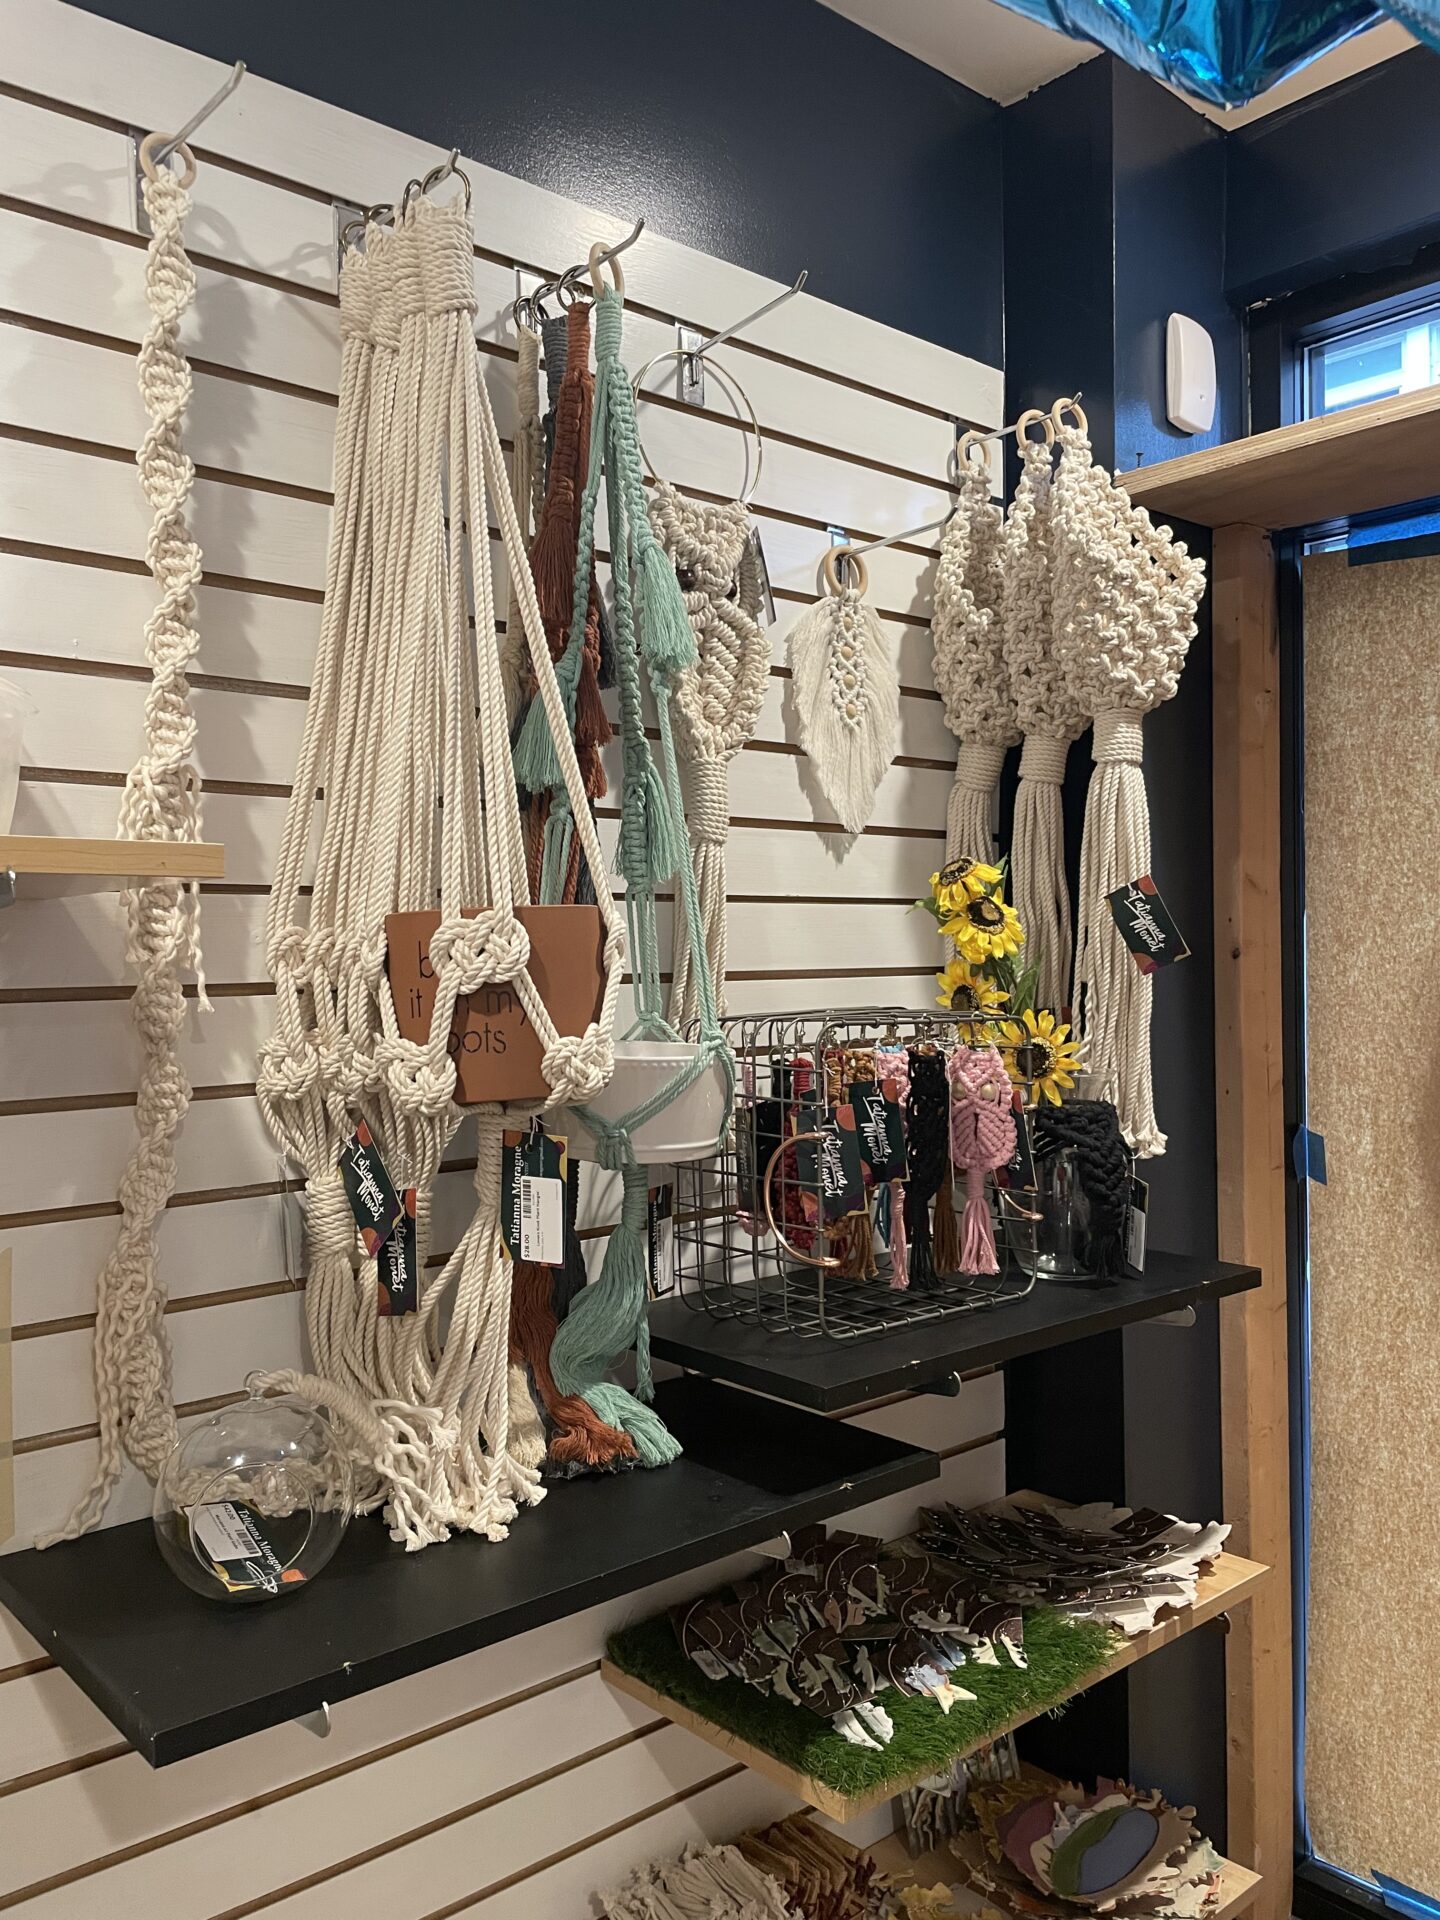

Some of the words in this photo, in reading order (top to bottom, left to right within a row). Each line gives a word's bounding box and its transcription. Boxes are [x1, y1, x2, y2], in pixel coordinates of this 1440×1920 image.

[1127, 890, 1167, 942] Tatianna
[1129, 918, 1166, 952] Monet
[409, 988, 422, 1019] it
[446, 1022, 507, 1054] oots
[860, 1122, 888, 1166] Monet
[866, 1092, 893, 1157] Tatianna
[351, 1144, 385, 1205] Tatianna
[511, 1145, 525, 1196] Moragne
[357, 1179, 385, 1222] Monet
[510, 1198, 521, 1246] Tatianna
[385, 1240, 404, 1293] Monet
[238, 1509, 262, 1541] Tatianna
[258, 1541, 284, 1573] Moragn
